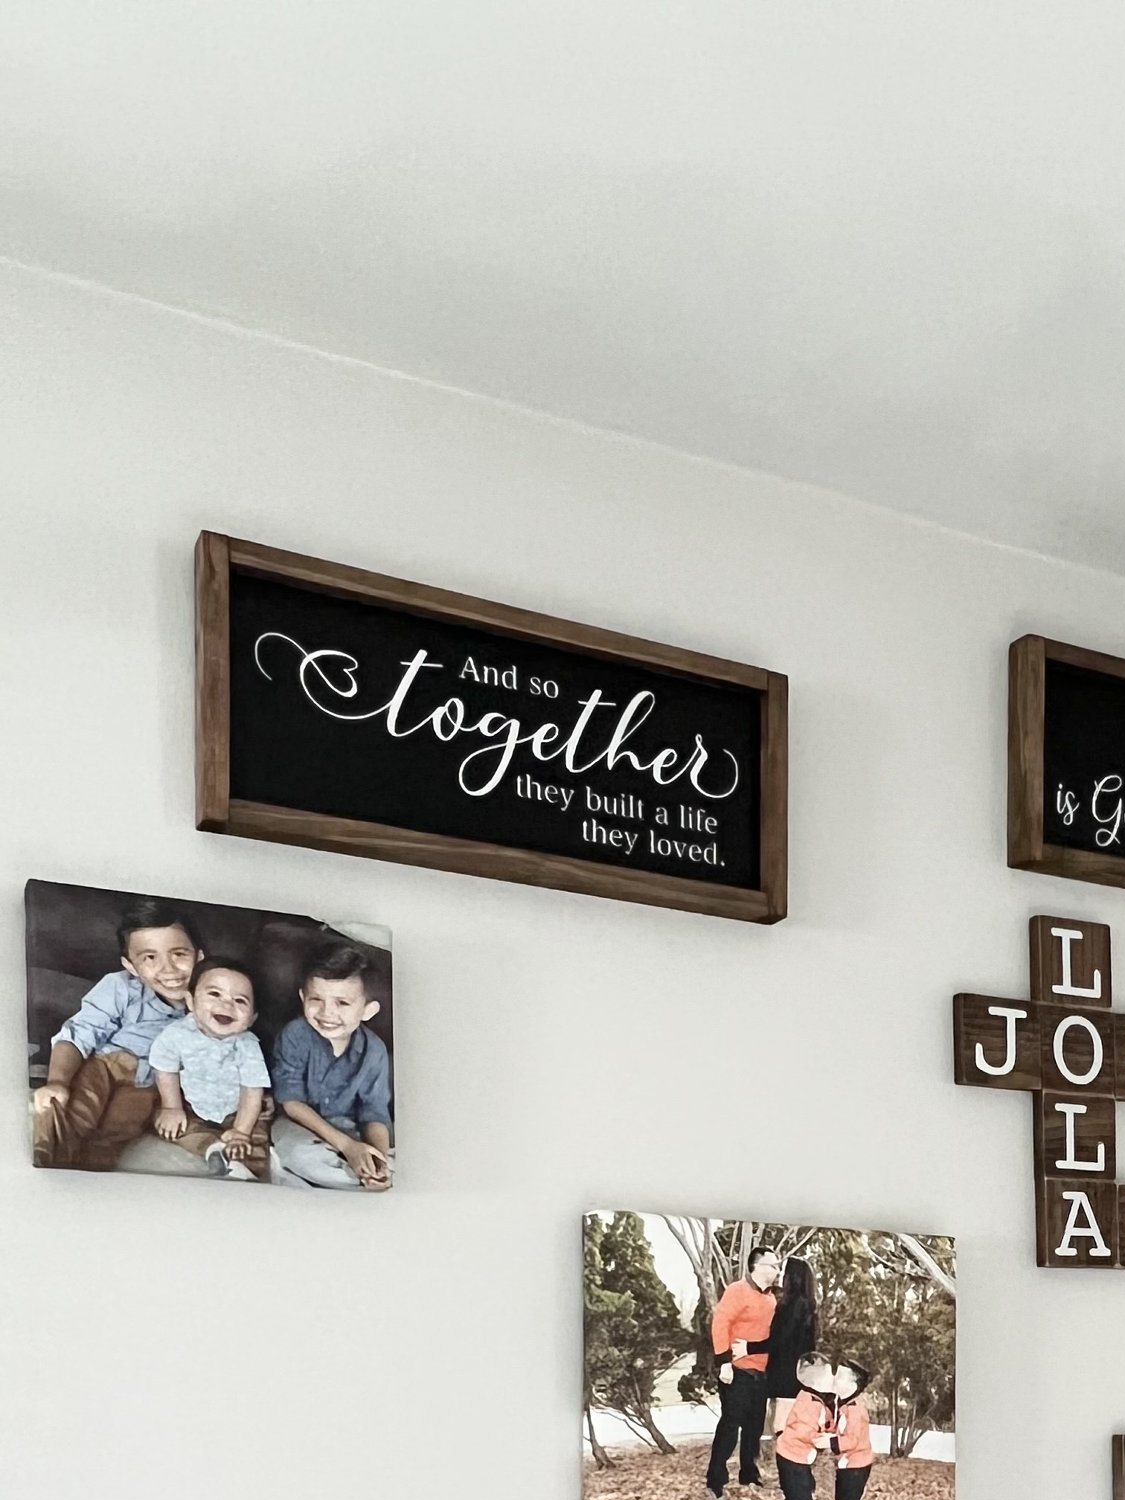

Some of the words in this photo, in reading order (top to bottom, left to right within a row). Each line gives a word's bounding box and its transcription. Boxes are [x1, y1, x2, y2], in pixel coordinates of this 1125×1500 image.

[459, 656, 518, 691] And
[529, 675, 560, 700] so
[300, 640, 740, 800] together
[516, 774, 574, 811] they
[587, 786, 643, 821] built
[655, 805, 669, 826] a
[679, 804, 719, 835] life
[1056, 783, 1080, 826] is
[583, 820, 638, 855] they
[649, 825, 726, 867] loved.
[1051, 926, 1112, 1257] LOLA
